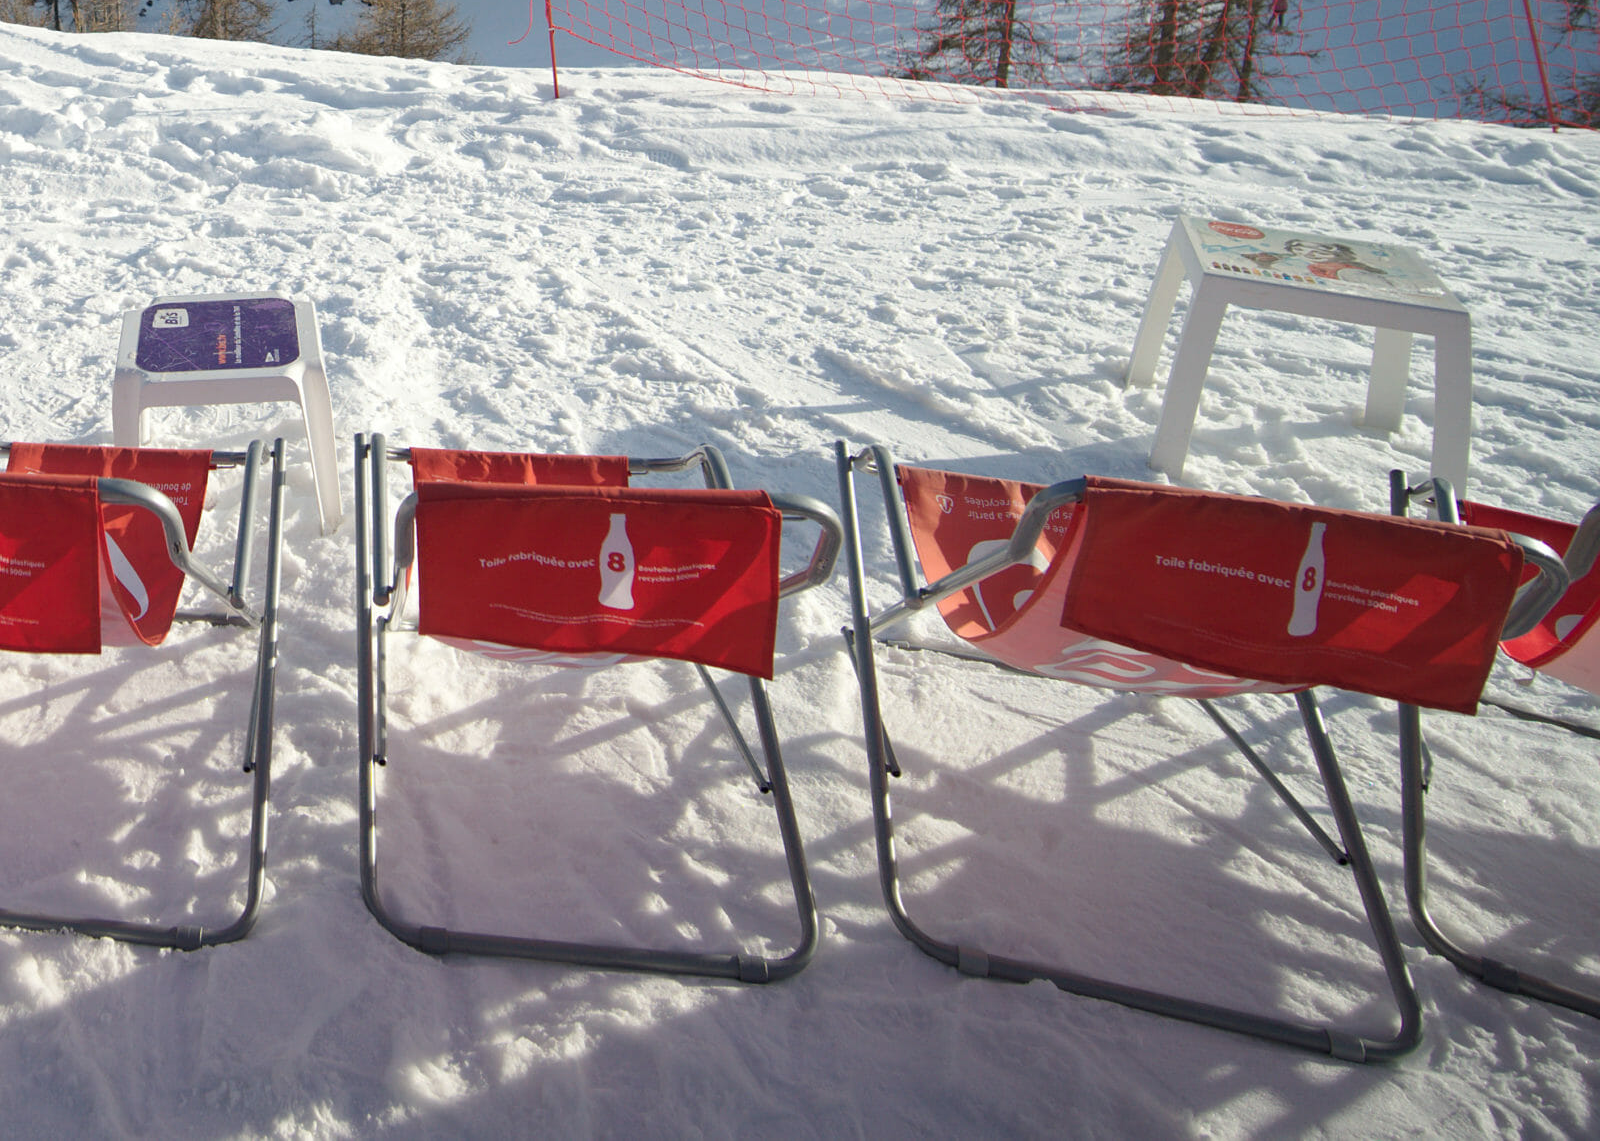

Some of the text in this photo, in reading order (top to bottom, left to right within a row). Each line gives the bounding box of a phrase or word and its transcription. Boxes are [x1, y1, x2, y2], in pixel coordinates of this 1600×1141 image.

[479, 557, 507, 568] Toile
[567, 558, 595, 568] avec
[607, 552, 625, 572] 8
[1155, 555, 1316, 592] Toile fabriquée avec 8
[1326, 579, 1419, 607] Bouteilles plastiques
